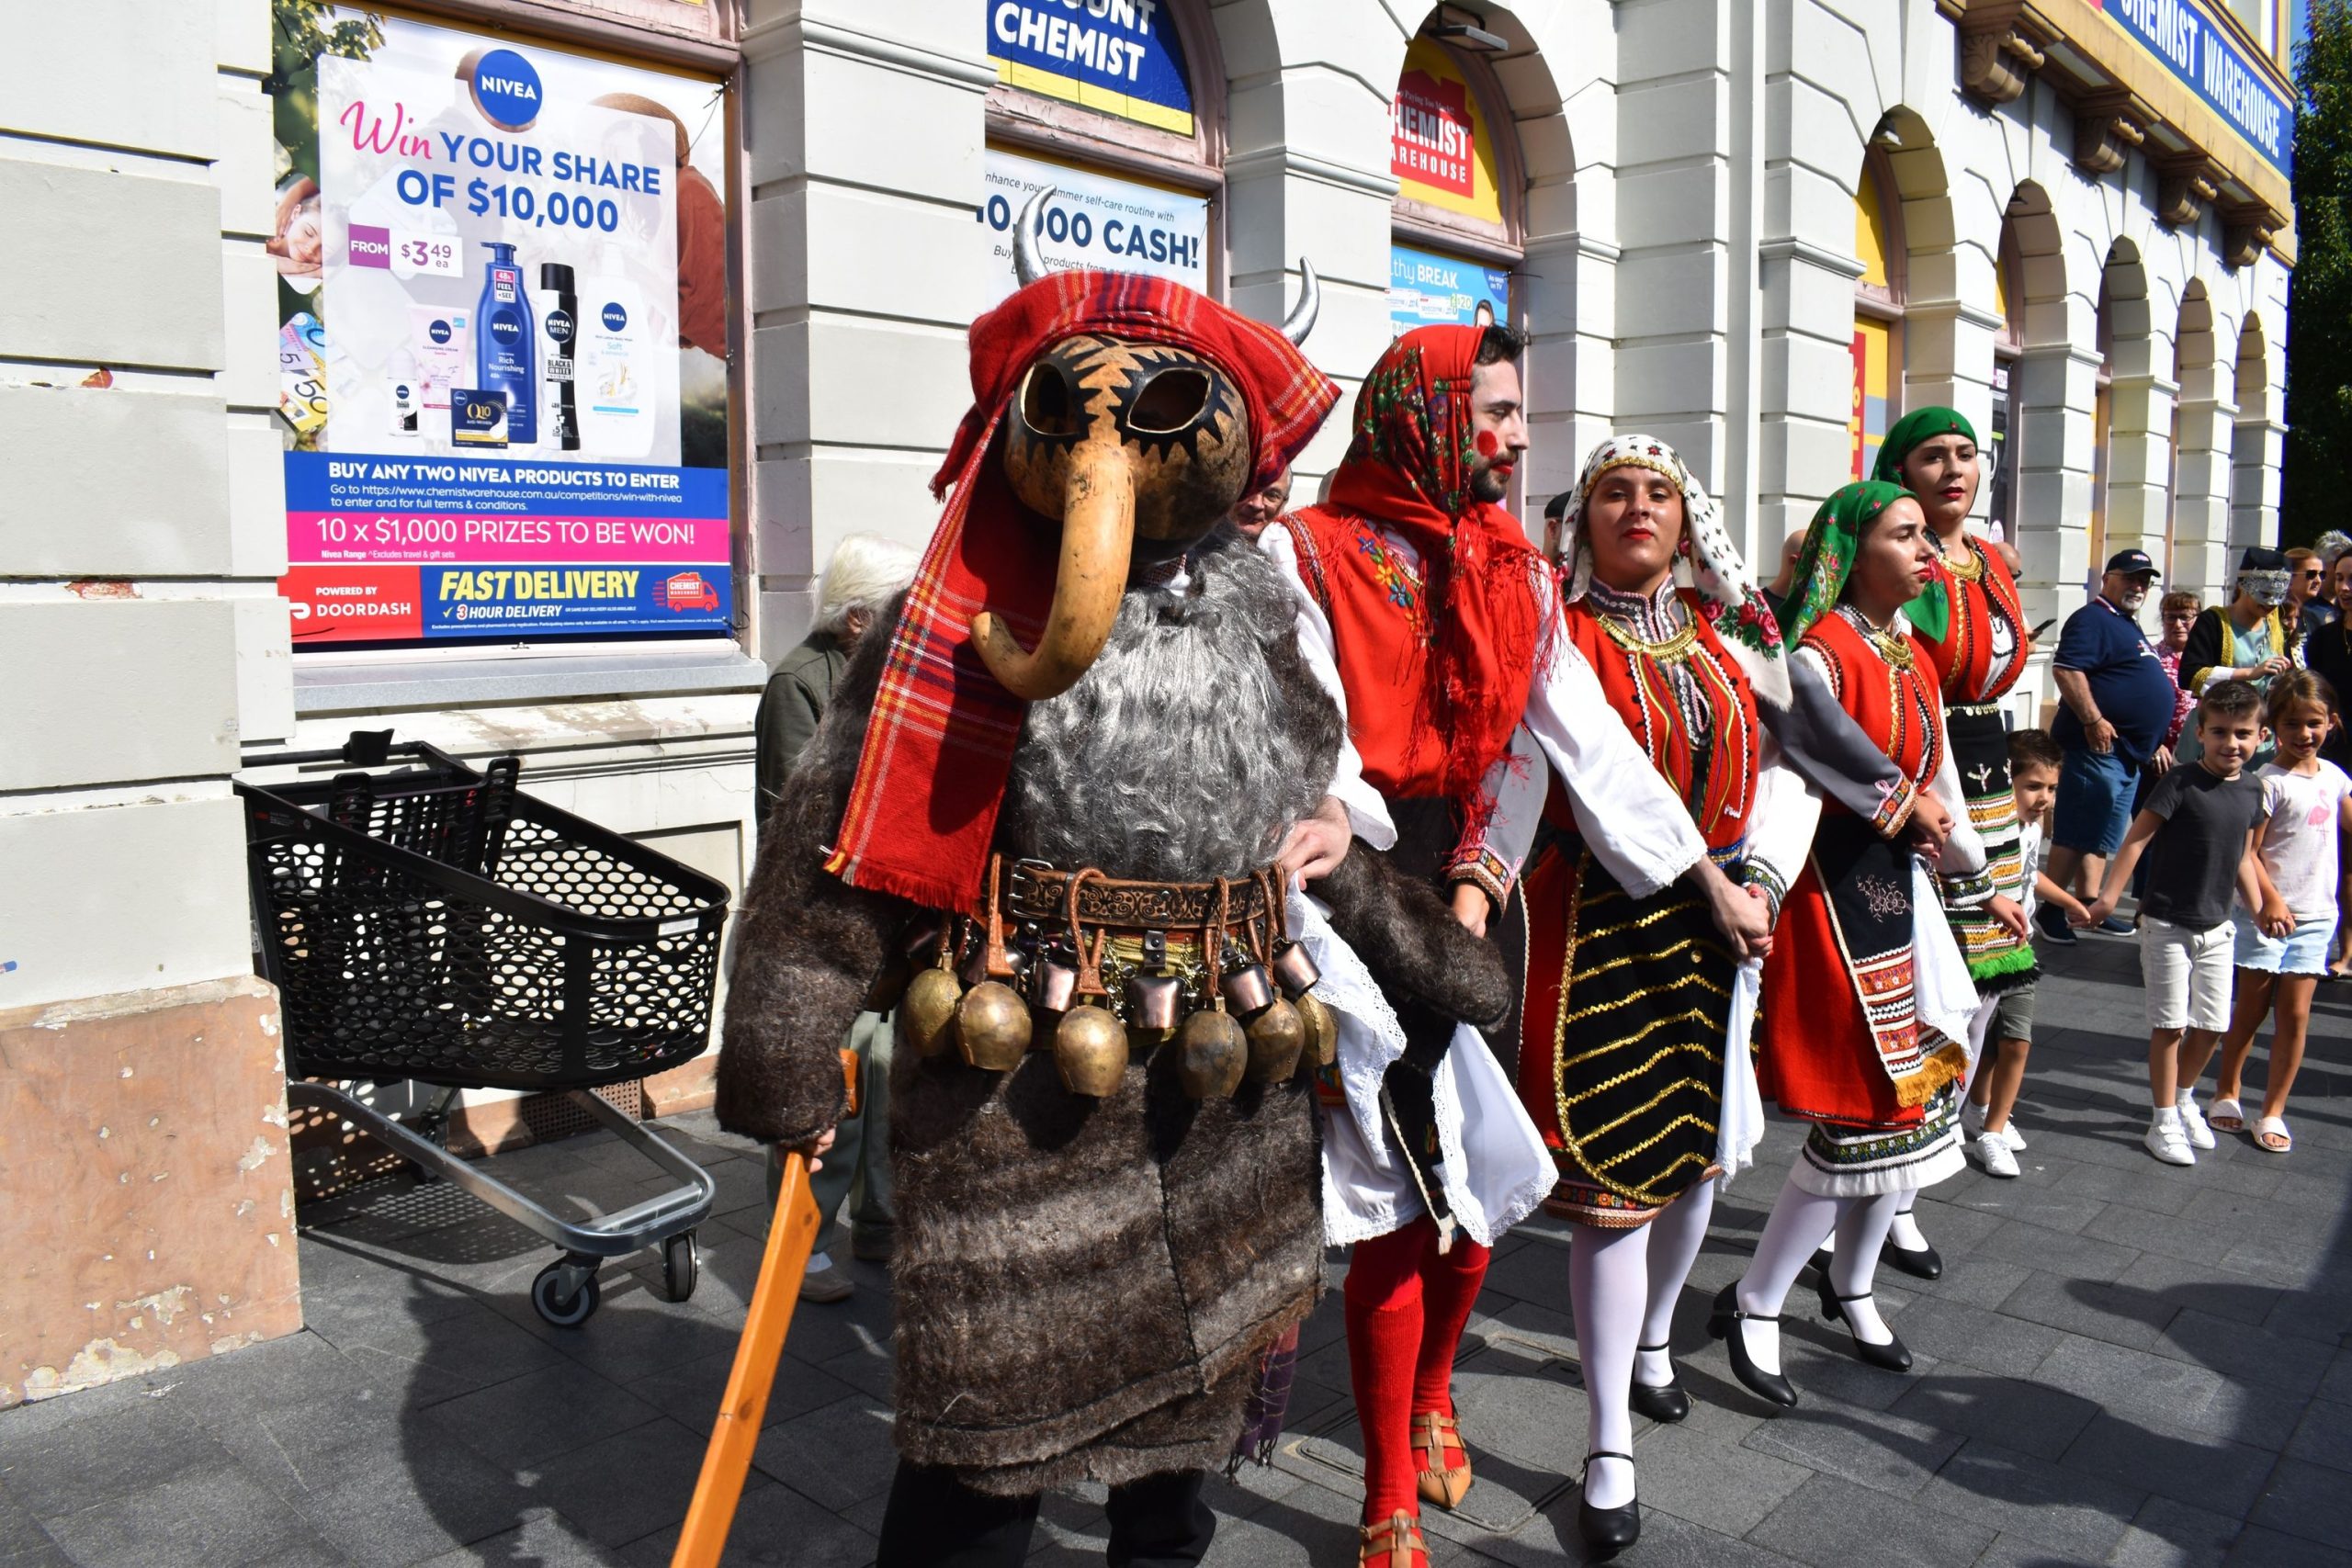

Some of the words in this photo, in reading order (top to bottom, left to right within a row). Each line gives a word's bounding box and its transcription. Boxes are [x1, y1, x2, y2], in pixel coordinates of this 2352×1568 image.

[995, 2, 1145, 82] CHEMIST
[481, 74, 537, 100] NIVEA
[2120, 0, 2198, 77] EMIST
[2205, 29, 2279, 158] WAREHOUSE
[1390, 103, 1468, 160] HEMIST
[340, 101, 433, 160] Win
[439, 132, 542, 175] YOUR
[553, 152, 661, 195] SHARE
[1391, 142, 1466, 183] AREHOUSE
[397, 169, 455, 208] OF
[468, 177, 618, 232] $10,000
[985, 172, 1020, 188] nhance
[1085, 195, 1123, 211] self-care
[1125, 204, 1155, 219] routine
[1158, 210, 1174, 222] with
[350, 240, 389, 255] FROM
[993, 244, 1013, 259] Buy
[1103, 220, 1198, 269] CASH!
[435, 260, 448, 268] ea
[1391, 257, 1415, 285] thy
[1418, 264, 1459, 289] BREAK
[548, 319, 571, 328] NIVEA
[604, 313, 625, 321] NIVEA
[492, 323, 519, 333] NIVEA
[549, 326, 568, 334] MEN
[498, 356, 514, 365] Rich
[488, 364, 525, 375] Nourishing
[467, 403, 492, 420] Q10
[329, 462, 368, 479] BUY
[371, 465, 410, 479] ANY
[413, 465, 456, 481] TWO
[459, 467, 511, 483] NIVEA
[515, 469, 602, 486] PRODUCTS
[605, 472, 627, 487] TO
[630, 473, 680, 489] ENTER
[331, 484, 345, 494] Go
[348, 485, 358, 494] to
[362, 485, 682, 502] https://www.chemistwarehouse.com.au/competitions/win-with-nivea
[331, 498, 342, 507] to
[345, 499, 373, 507] enter
[376, 499, 397, 508] and
[399, 499, 414, 508] for
[416, 499, 432, 509] full
[435, 500, 463, 509] terms
[465, 500, 473, 509] &
[475, 501, 528, 511] conditions.
[316, 518, 346, 542] 10
[354, 525, 369, 542] x
[375, 516, 457, 546] $1,000
[465, 520, 551, 544] PRIZES
[556, 521, 589, 544] TO
[596, 523, 625, 544] BE
[630, 523, 695, 545] WON!
[322, 550, 342, 558] Nivea
[344, 550, 367, 560] Range
[403, 550, 421, 558] travel
[429, 551, 441, 560] gift
[316, 586, 362, 596] POWERED
[365, 586, 378, 595] BY
[439, 571, 513, 601] FAST
[514, 570, 639, 600] DELIVERY
[670, 581, 699, 590] CHEMIST
[317, 603, 412, 616] DOORDASH
[457, 604, 468, 621] 3
[469, 606, 503, 618] HOUR
[505, 605, 562, 618] DELIVERY
